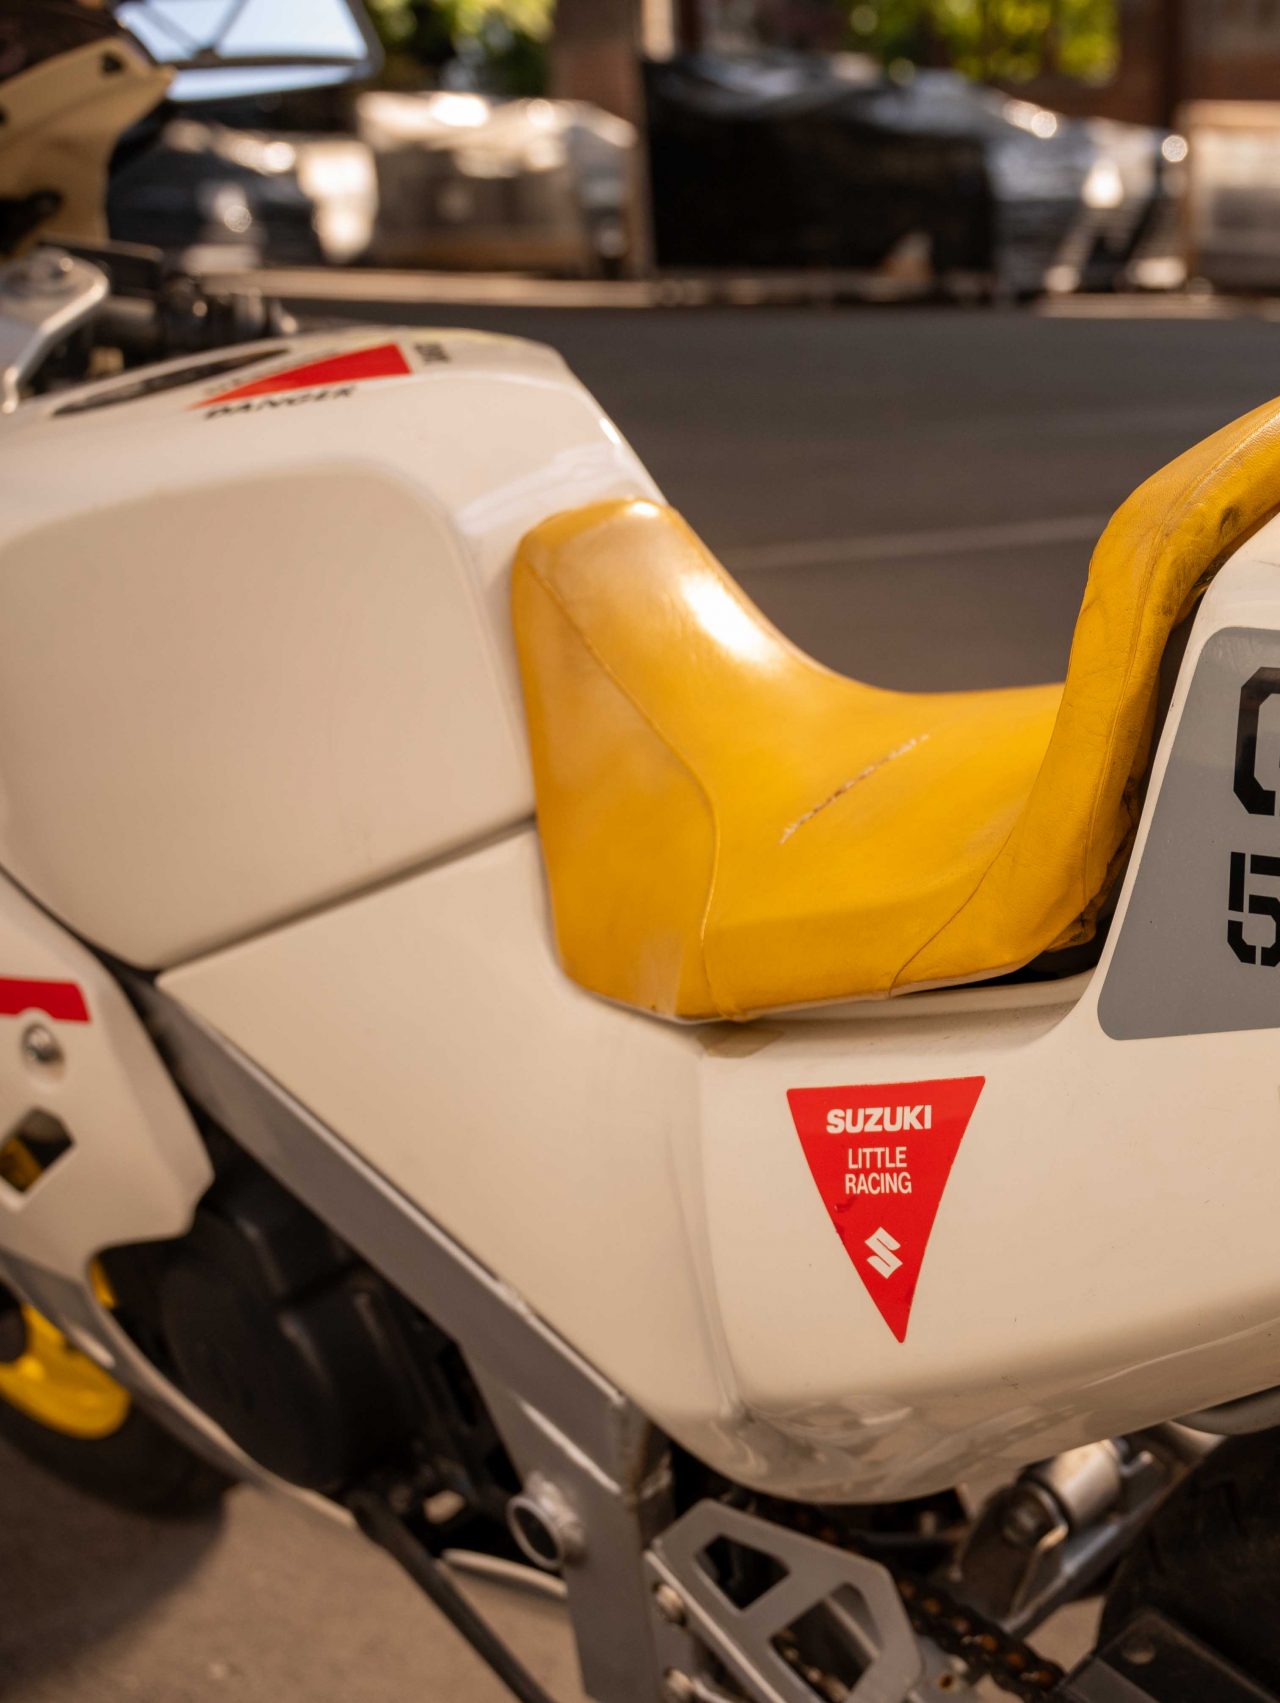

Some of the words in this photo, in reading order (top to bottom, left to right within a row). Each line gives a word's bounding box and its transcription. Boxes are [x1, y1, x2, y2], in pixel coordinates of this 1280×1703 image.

[826, 1104, 932, 1134] SUZUKI
[848, 1146, 907, 1169] LITTLE
[845, 1171, 912, 1195] RACING
